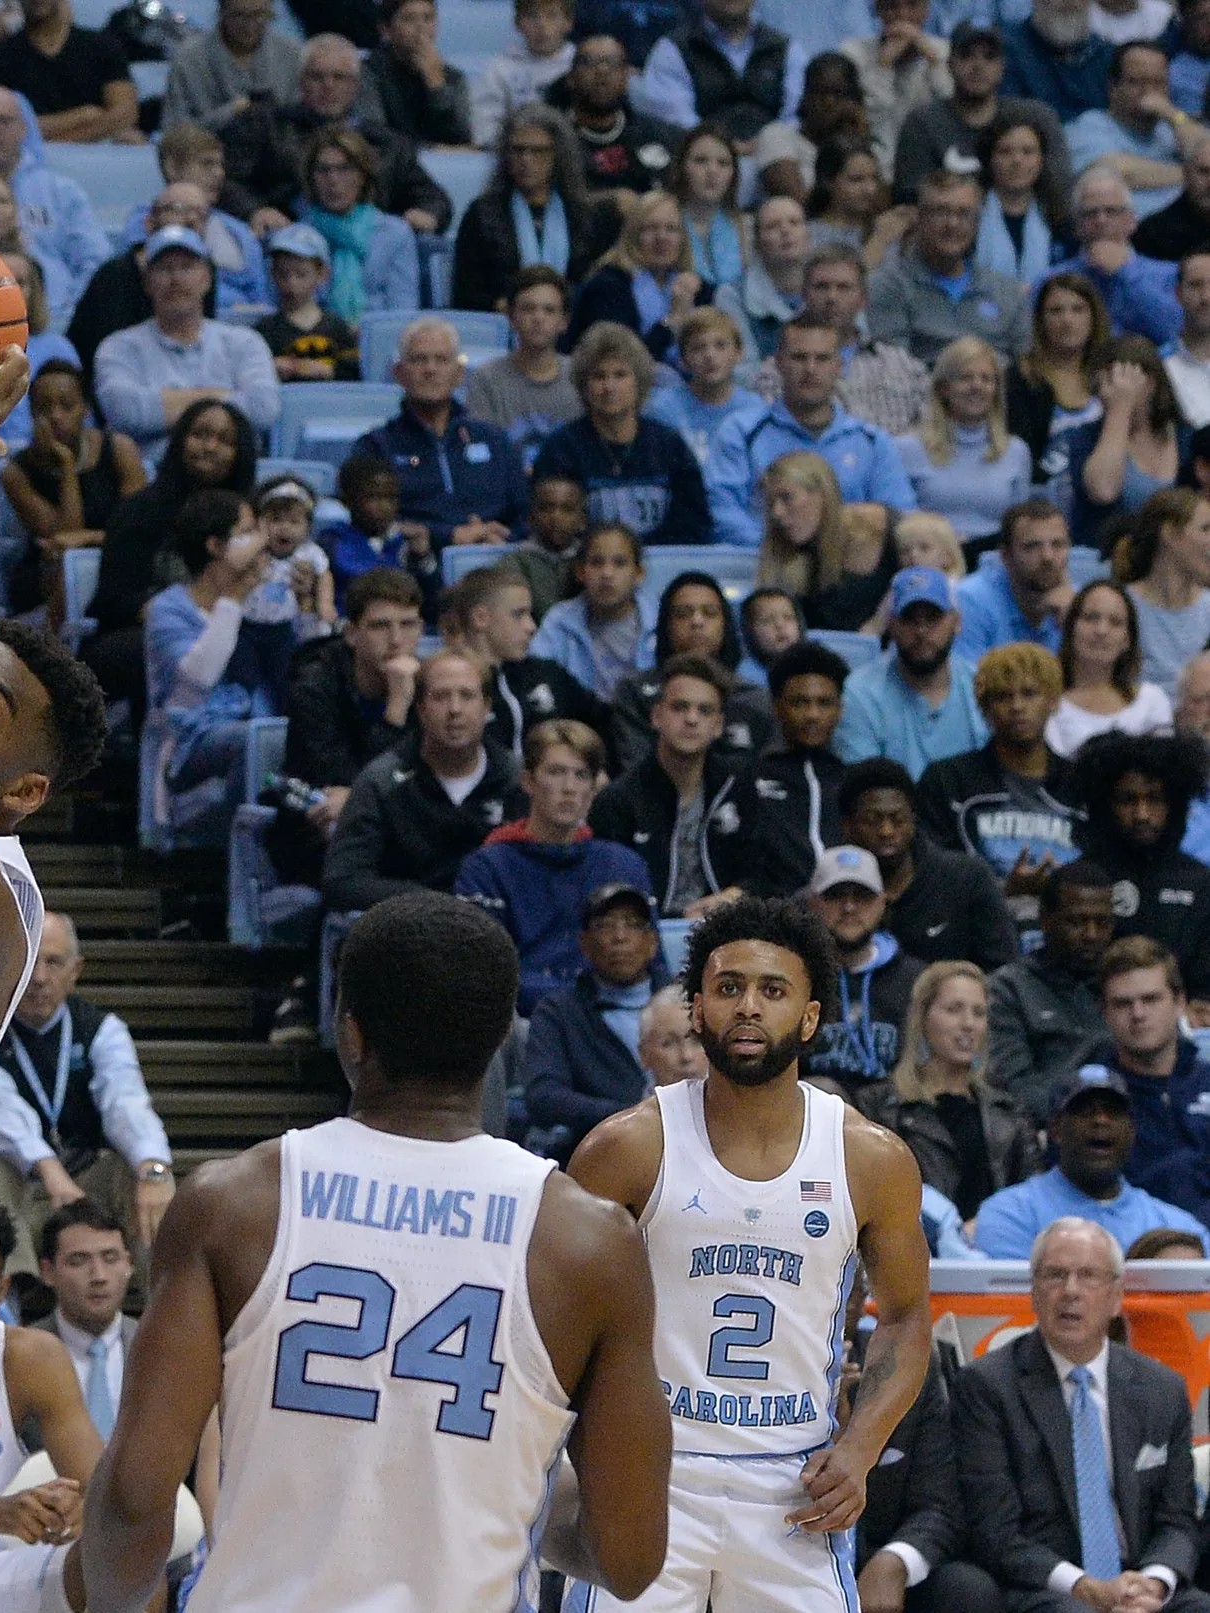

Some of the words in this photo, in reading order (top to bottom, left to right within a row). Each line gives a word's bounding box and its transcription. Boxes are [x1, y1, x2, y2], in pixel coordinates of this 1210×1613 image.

[301, 1170, 476, 1239] WILLIAMS
[689, 1243, 804, 1287] NORTH
[271, 1262, 505, 1441] 24
[706, 1292, 776, 1380] 2
